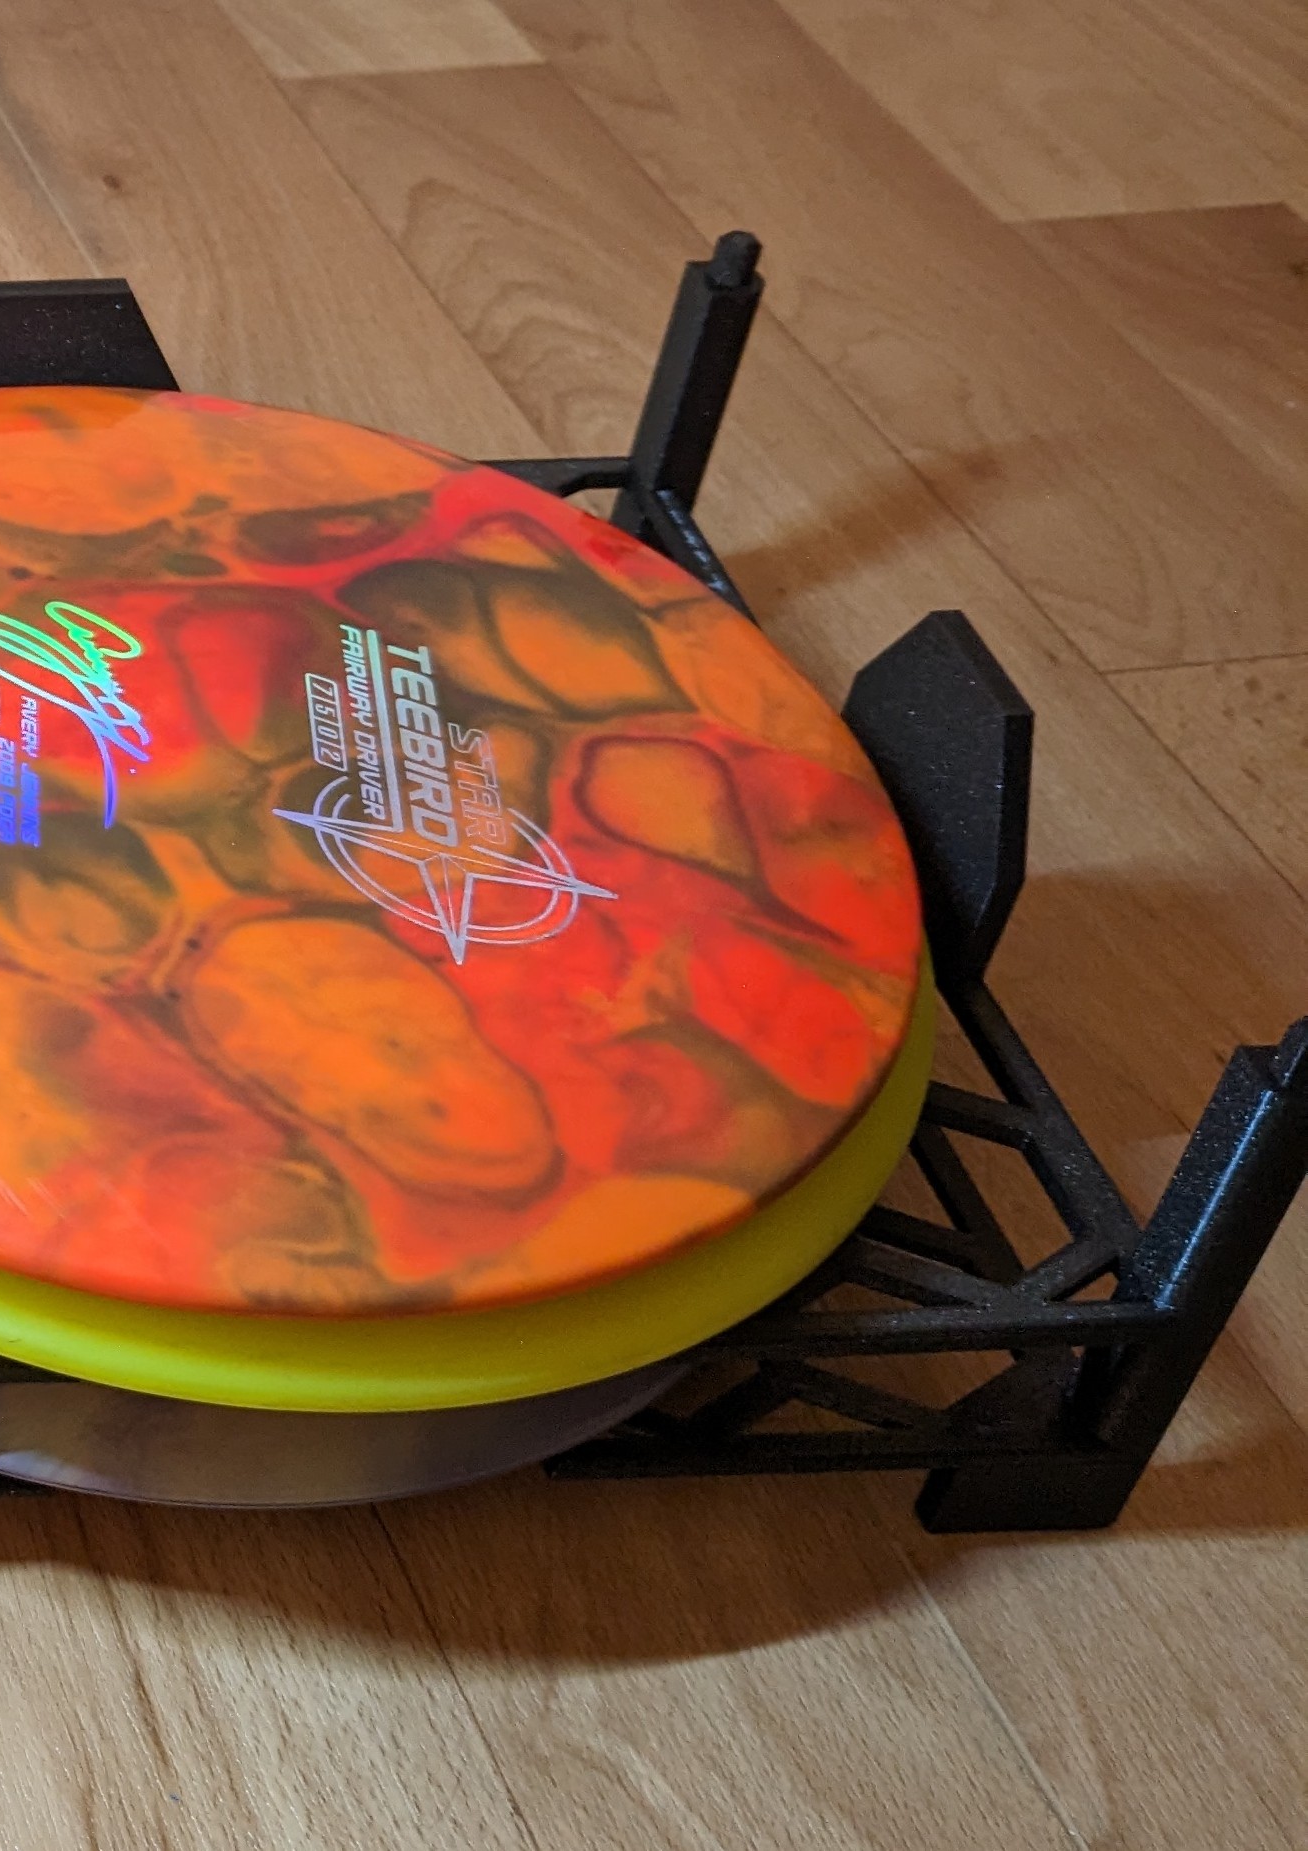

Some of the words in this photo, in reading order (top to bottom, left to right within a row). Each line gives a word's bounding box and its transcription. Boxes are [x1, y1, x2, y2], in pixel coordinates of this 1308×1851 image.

[20, 695, 38, 758] AVERY
[339, 624, 373, 729] FAIRWAY
[353, 730, 385, 821] DRIVER
[387, 645, 459, 848] TEEBIRD
[448, 722, 507, 846] STAR
